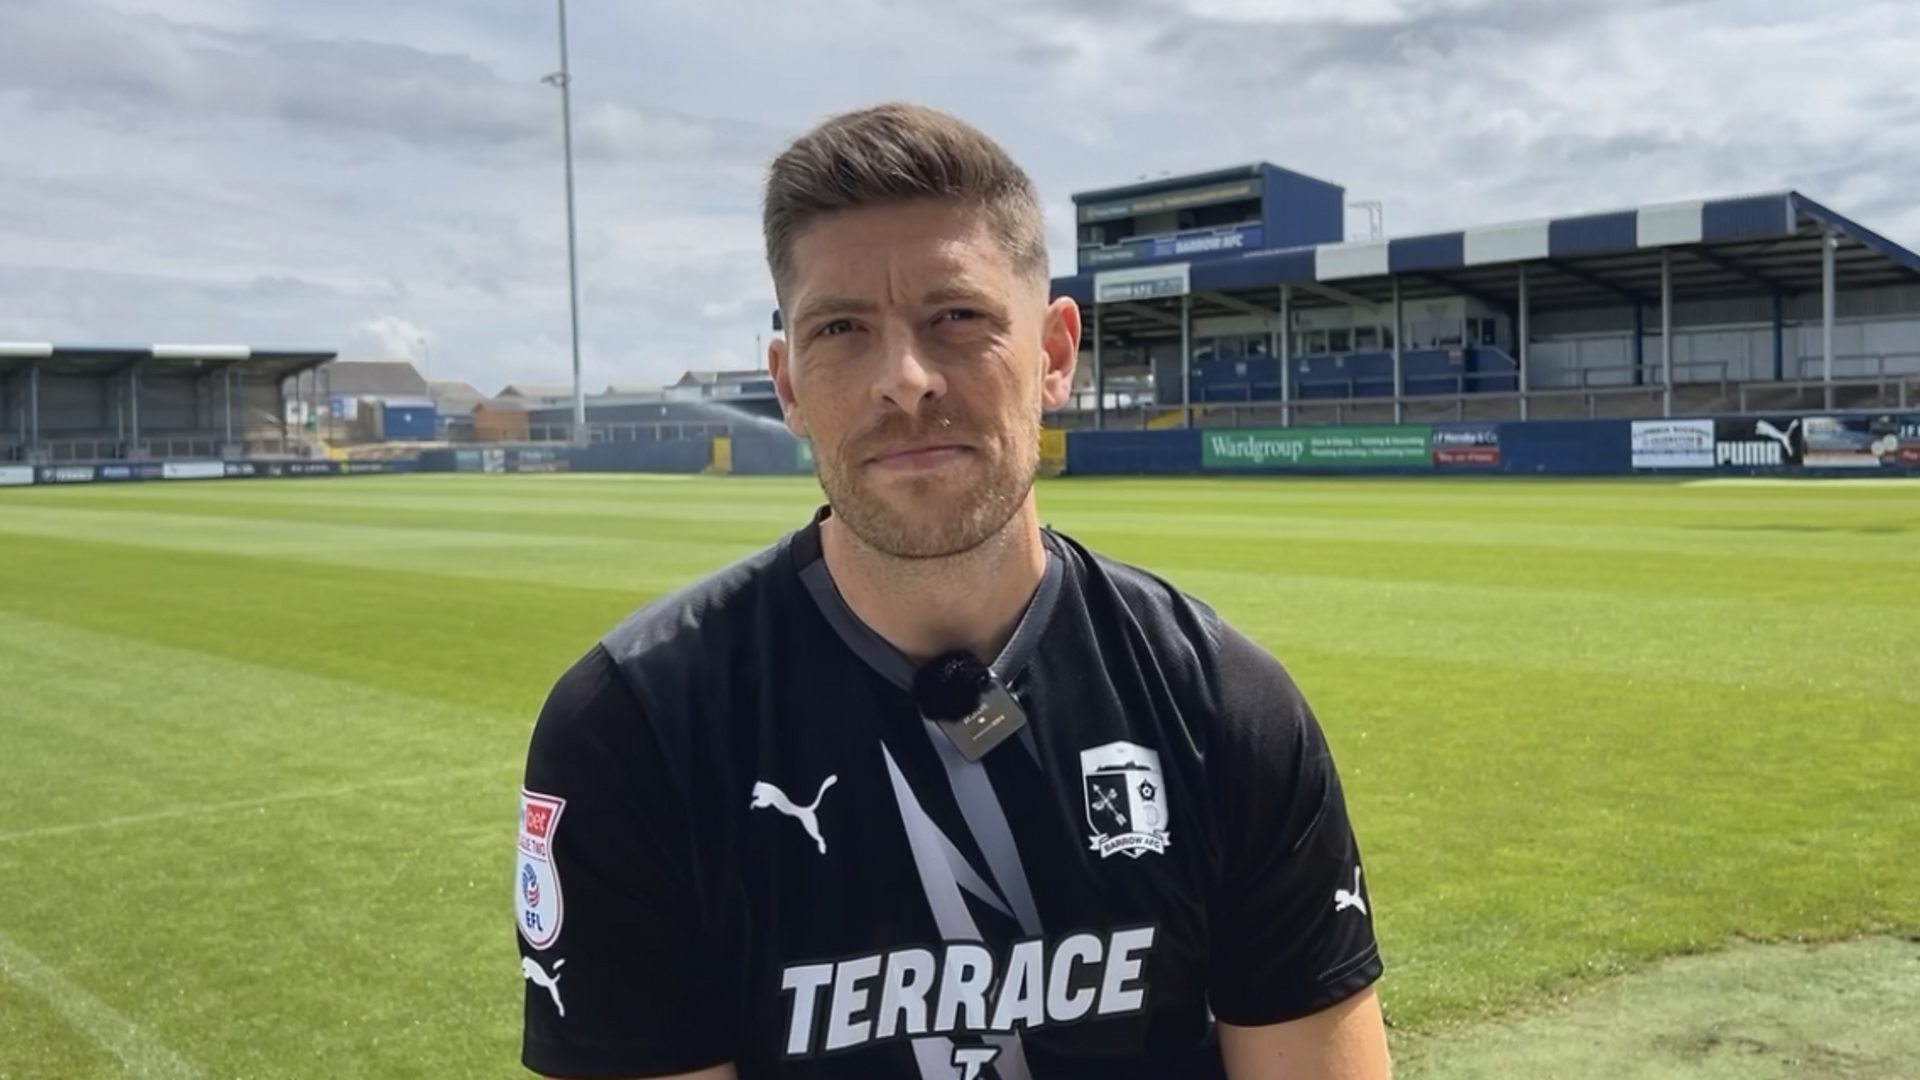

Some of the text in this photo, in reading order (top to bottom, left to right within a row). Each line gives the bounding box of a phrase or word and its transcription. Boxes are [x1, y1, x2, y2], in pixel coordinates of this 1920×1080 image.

[1175, 235, 1220, 254] BARROW
[1221, 233, 1244, 248] AFC
[1211, 434, 1303, 463] Wardgroup
[1717, 441, 1781, 465] PUMA
[1103, 835, 1161, 853] BARROW AFC
[525, 910, 544, 933] EFL
[781, 926, 1155, 1056] TERRACE
